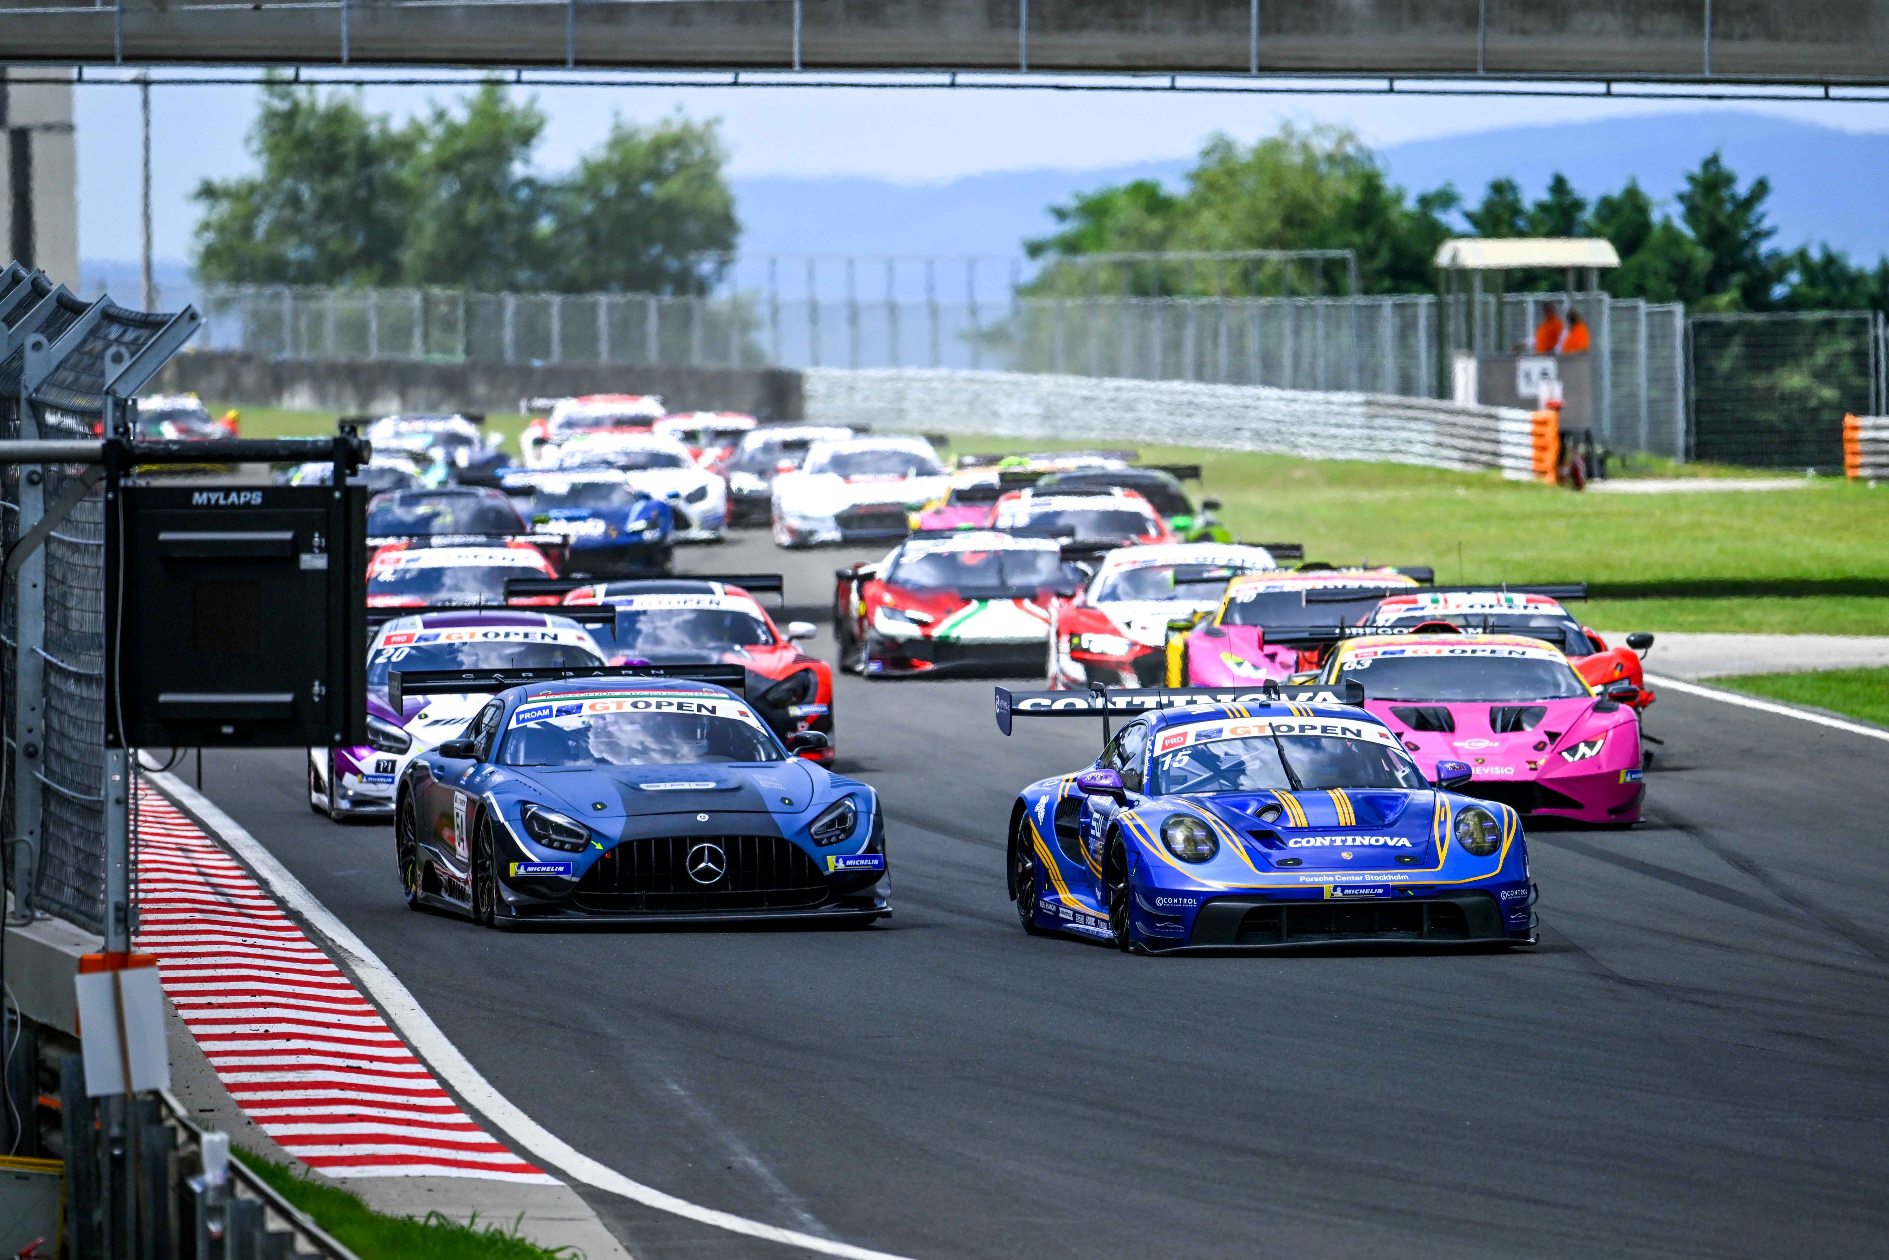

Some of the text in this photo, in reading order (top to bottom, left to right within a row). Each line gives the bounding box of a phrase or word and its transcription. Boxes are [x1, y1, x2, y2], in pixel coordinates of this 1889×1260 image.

[191, 491, 263, 505] MYLAPS
[390, 634, 408, 643] PRO
[374, 646, 411, 664] 20
[1342, 658, 1373, 671] 63
[518, 708, 551, 721] PROAM
[1163, 736, 1184, 747] PRO
[1159, 750, 1192, 771] 15
[1472, 766, 1515, 775] EVISIO
[1288, 835, 1413, 848] CONTINOVA
[845, 858, 880, 866] MICHELIN
[1299, 873, 1409, 883] Porsche Center Stockholm
[1343, 887, 1385, 895] MICHELIN
[1163, 897, 1198, 905] CONTROL
